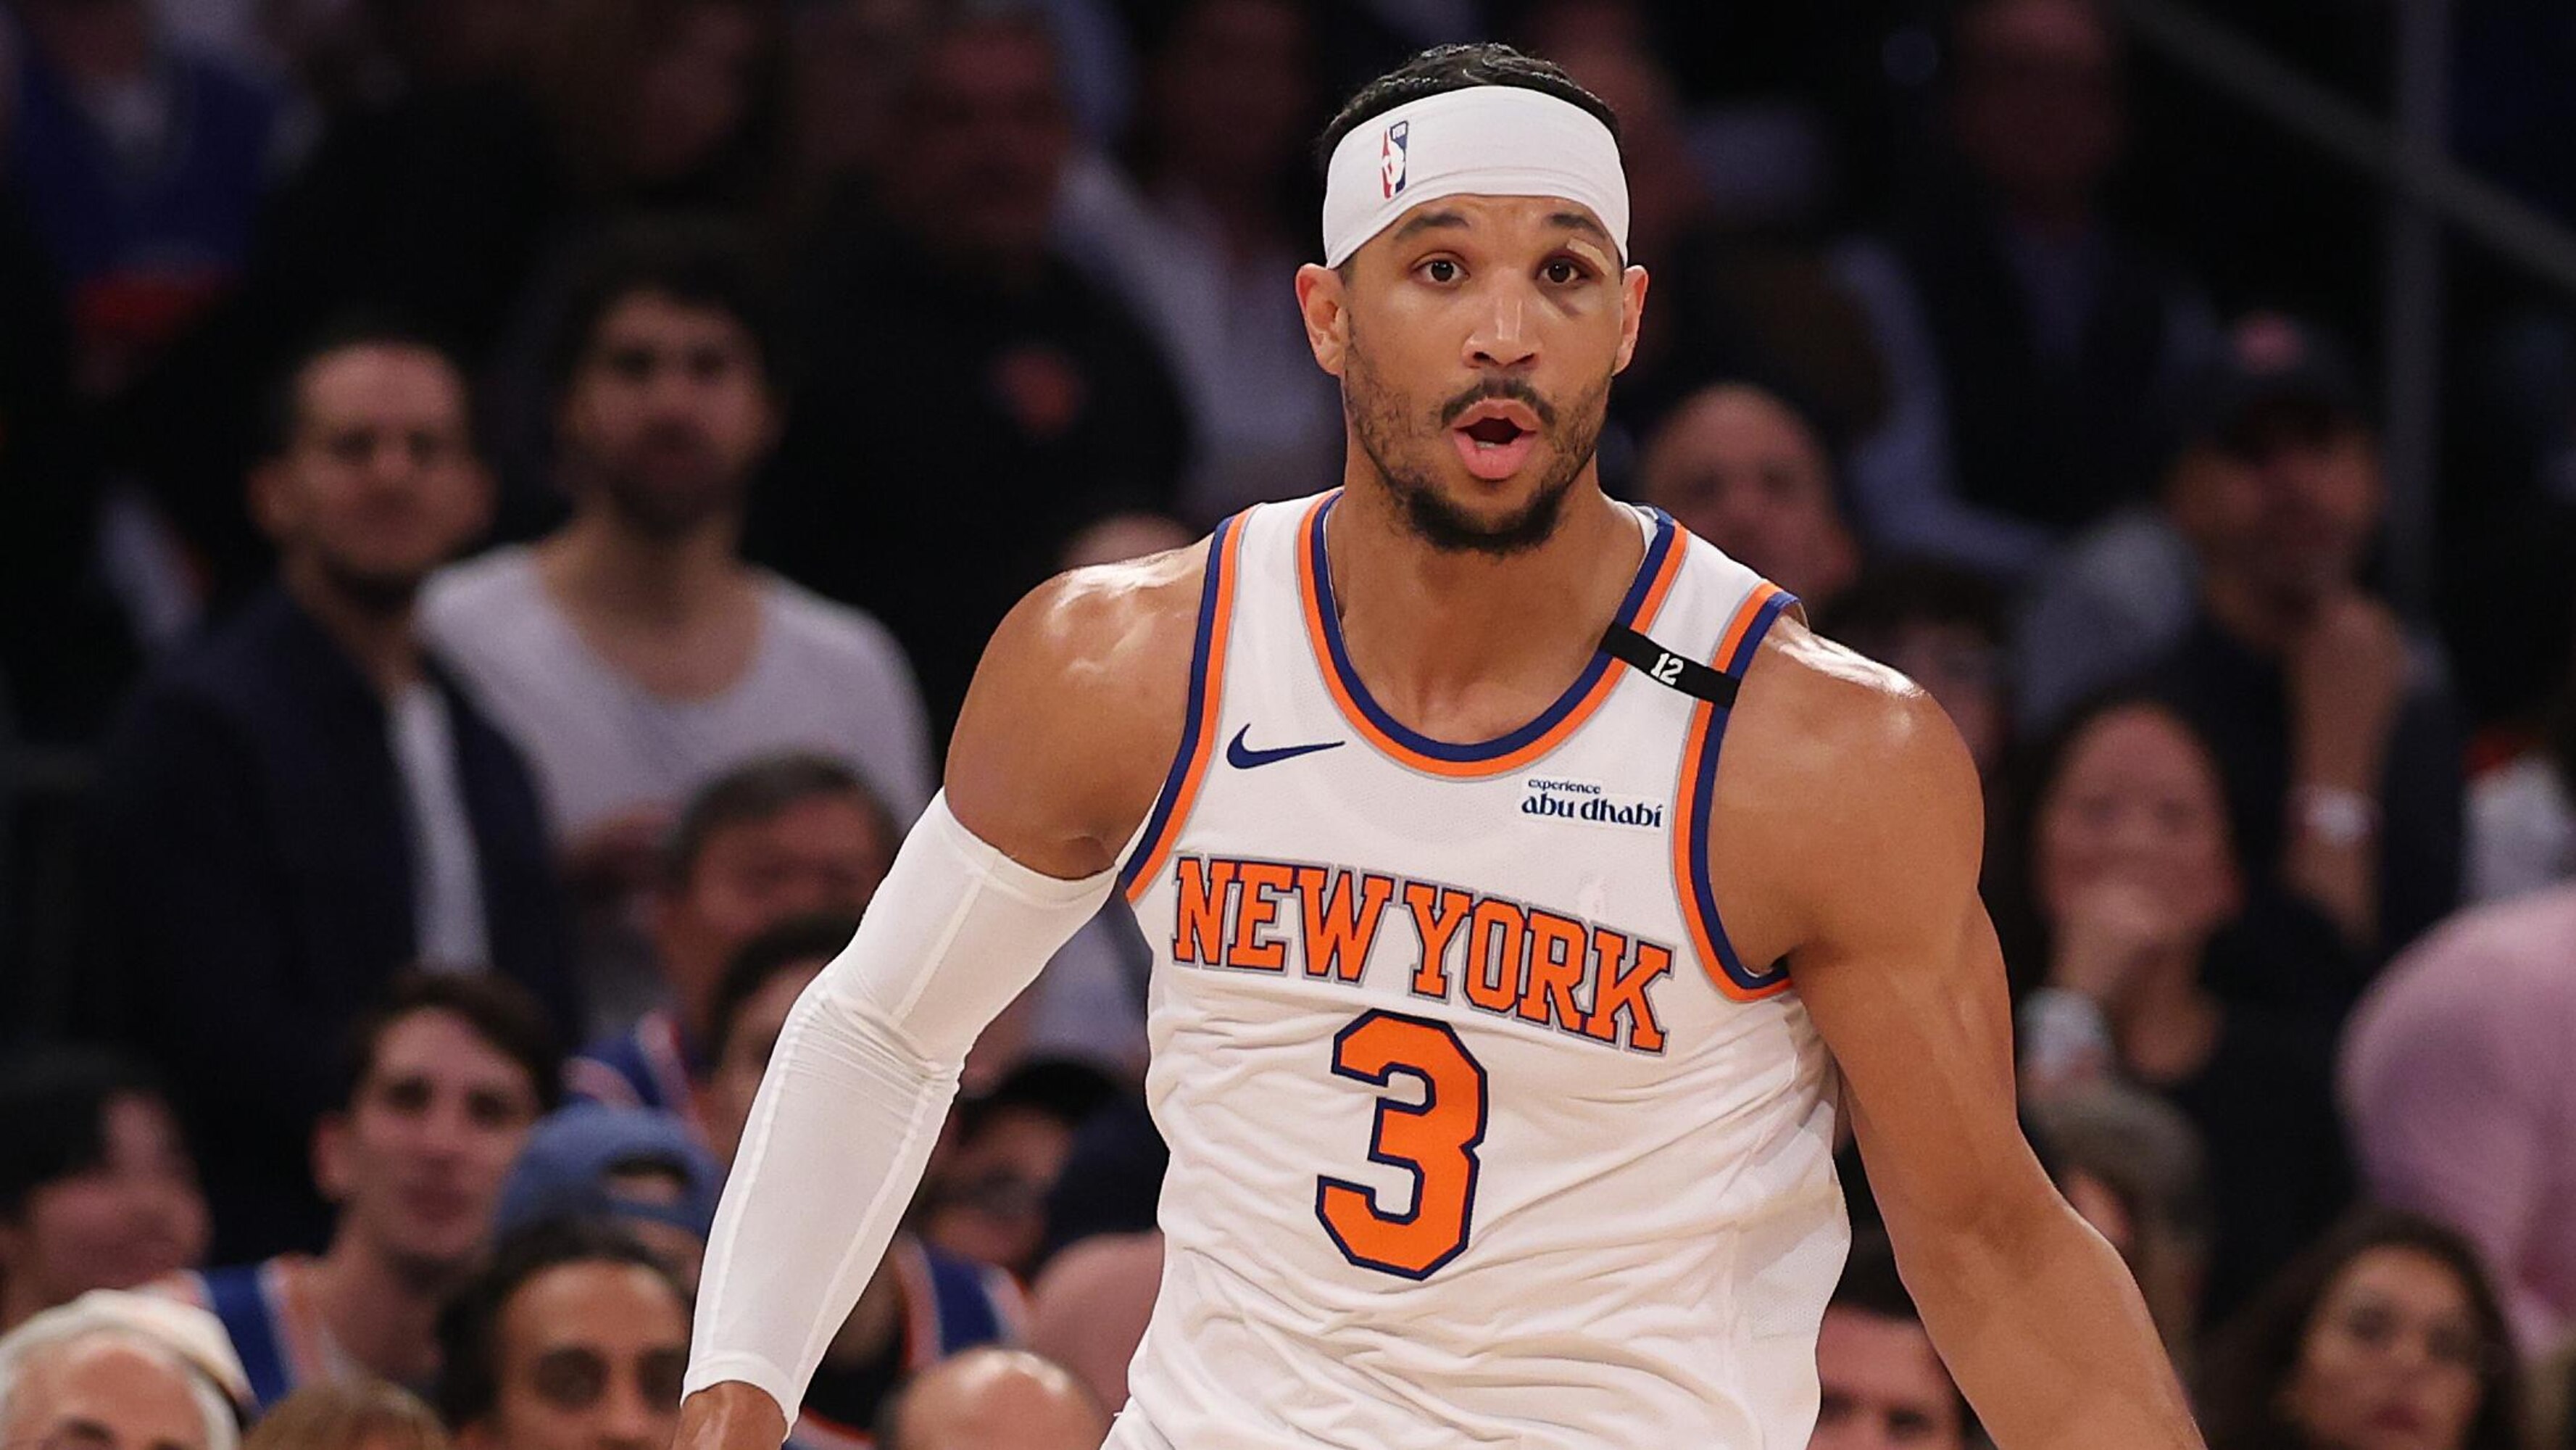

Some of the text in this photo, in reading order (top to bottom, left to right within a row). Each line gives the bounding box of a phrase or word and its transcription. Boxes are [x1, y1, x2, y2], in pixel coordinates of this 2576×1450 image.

[1650, 652, 1684, 685] 12
[1528, 779, 1601, 795] experience
[1521, 792, 1663, 828] abu dhabi
[1173, 853, 1677, 1057] NEW YORK
[1315, 1008, 1489, 1281] 3
